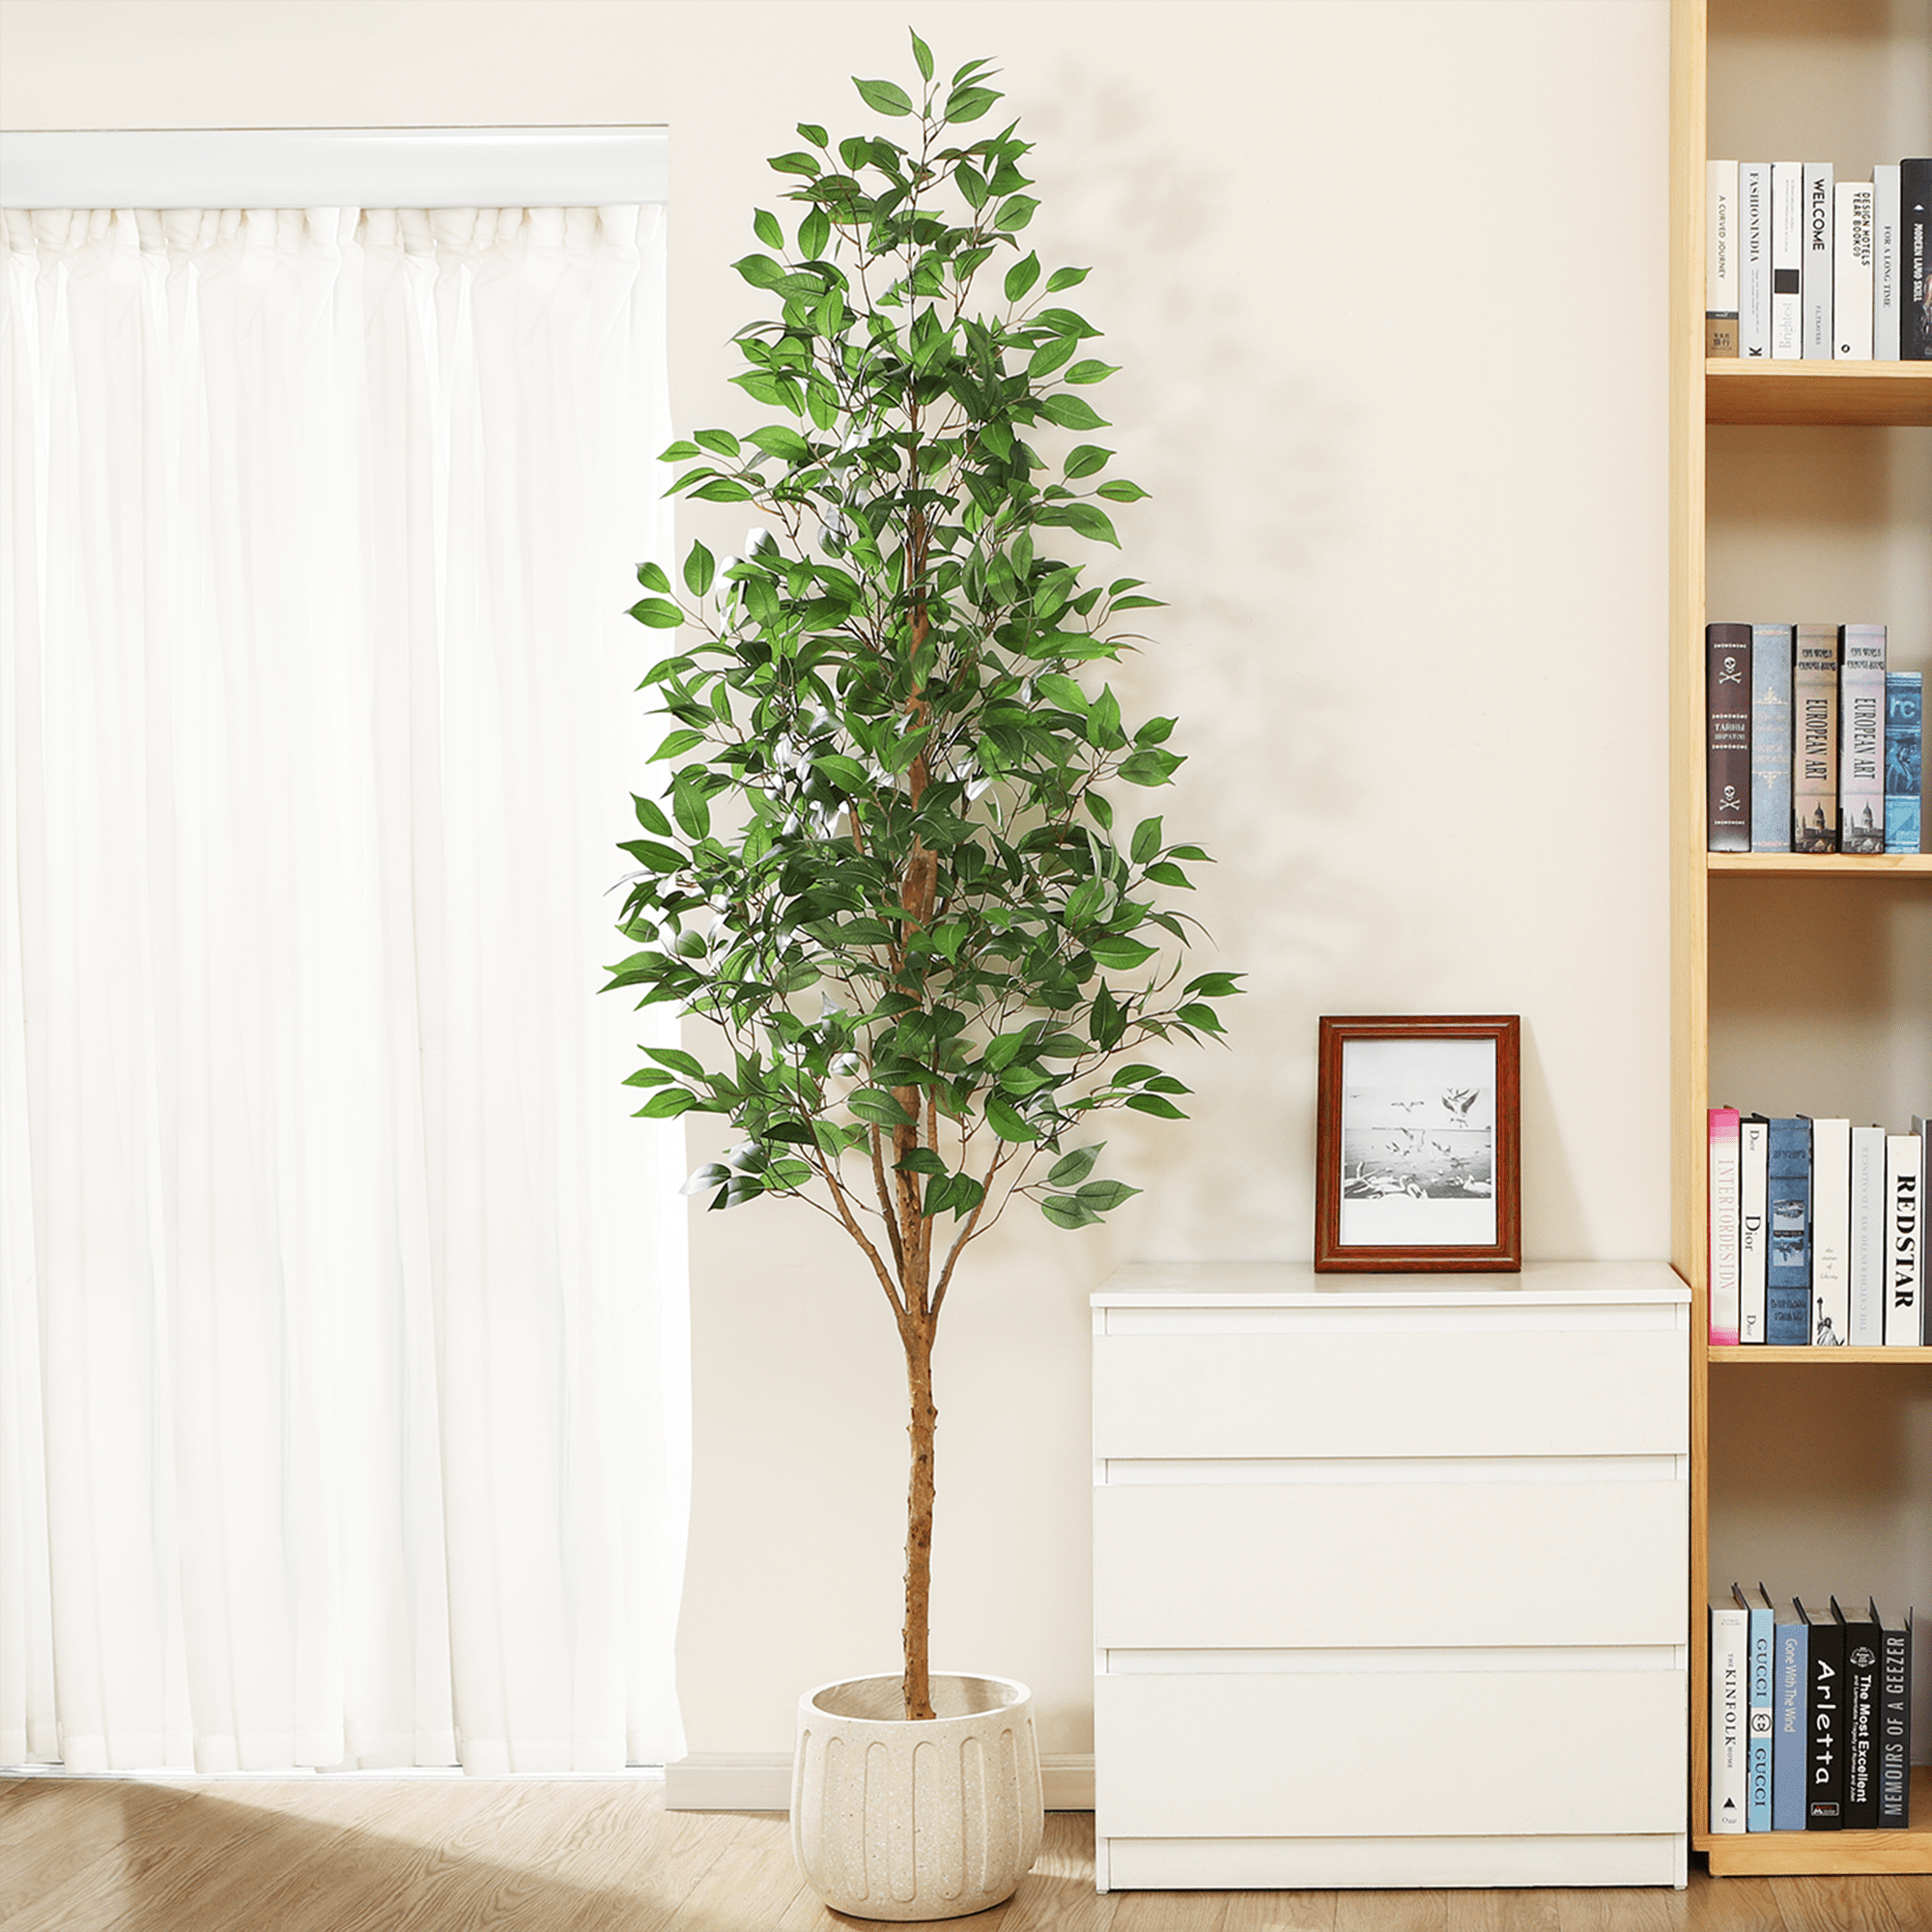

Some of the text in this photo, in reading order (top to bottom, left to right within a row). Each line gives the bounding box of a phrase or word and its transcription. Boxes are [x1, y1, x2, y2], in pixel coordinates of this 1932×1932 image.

[1749, 172, 1760, 263] FASHIONINDIA
[1812, 178, 1826, 251] WELCOME
[1853, 191, 1862, 217] YEAR
[1861, 191, 1871, 267] DESIGN HOTELS
[1914, 223, 1923, 257] MODERN
[1883, 255, 1891, 283] LONG
[1913, 281, 1922, 303] SKILL
[1805, 699, 1828, 781] EUROPEAN ART
[1854, 697, 1876, 780] EUROPEAN ART
[1749, 1129, 1760, 1151] Dior
[1745, 1215, 1761, 1252] Dior
[1894, 1175, 1917, 1309] REDSTAR
[1746, 1315, 1757, 1337] Dior
[1756, 1638, 1768, 1697] GUCCI
[1784, 1638, 1798, 1733] Gone With The Wind
[1724, 1669, 1737, 1747] KINFOLK
[1815, 1660, 1836, 1785] Arletta
[1857, 1674, 1872, 1803] The Most Excellent
[1884, 1636, 1905, 1816] MEMOIRS OF A GEEZER
[1755, 1747, 1767, 1806] GUCCI
